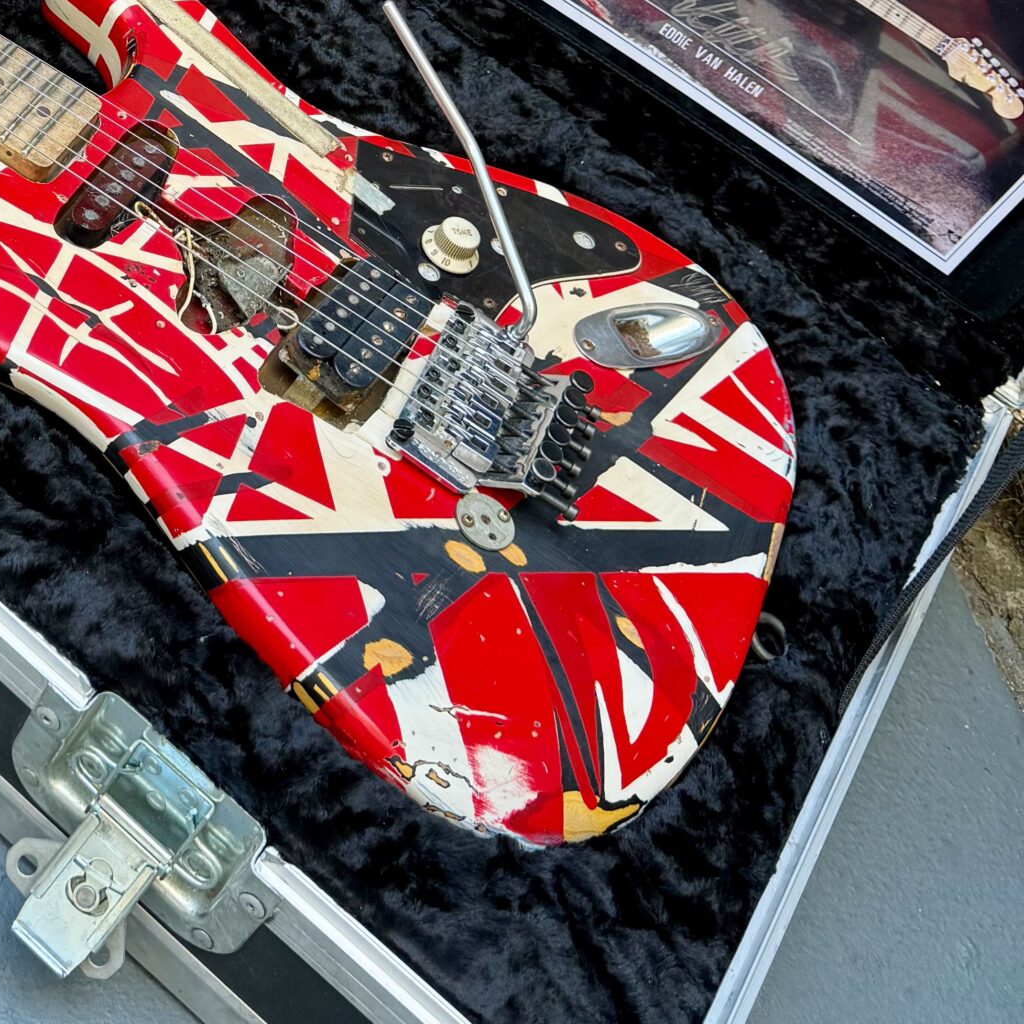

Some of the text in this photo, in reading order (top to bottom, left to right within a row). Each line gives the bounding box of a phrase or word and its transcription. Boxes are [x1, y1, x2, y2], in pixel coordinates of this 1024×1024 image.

[659, 23, 764, 98] EDDIE VAN HALEN
[441, 257, 451, 266] 10
